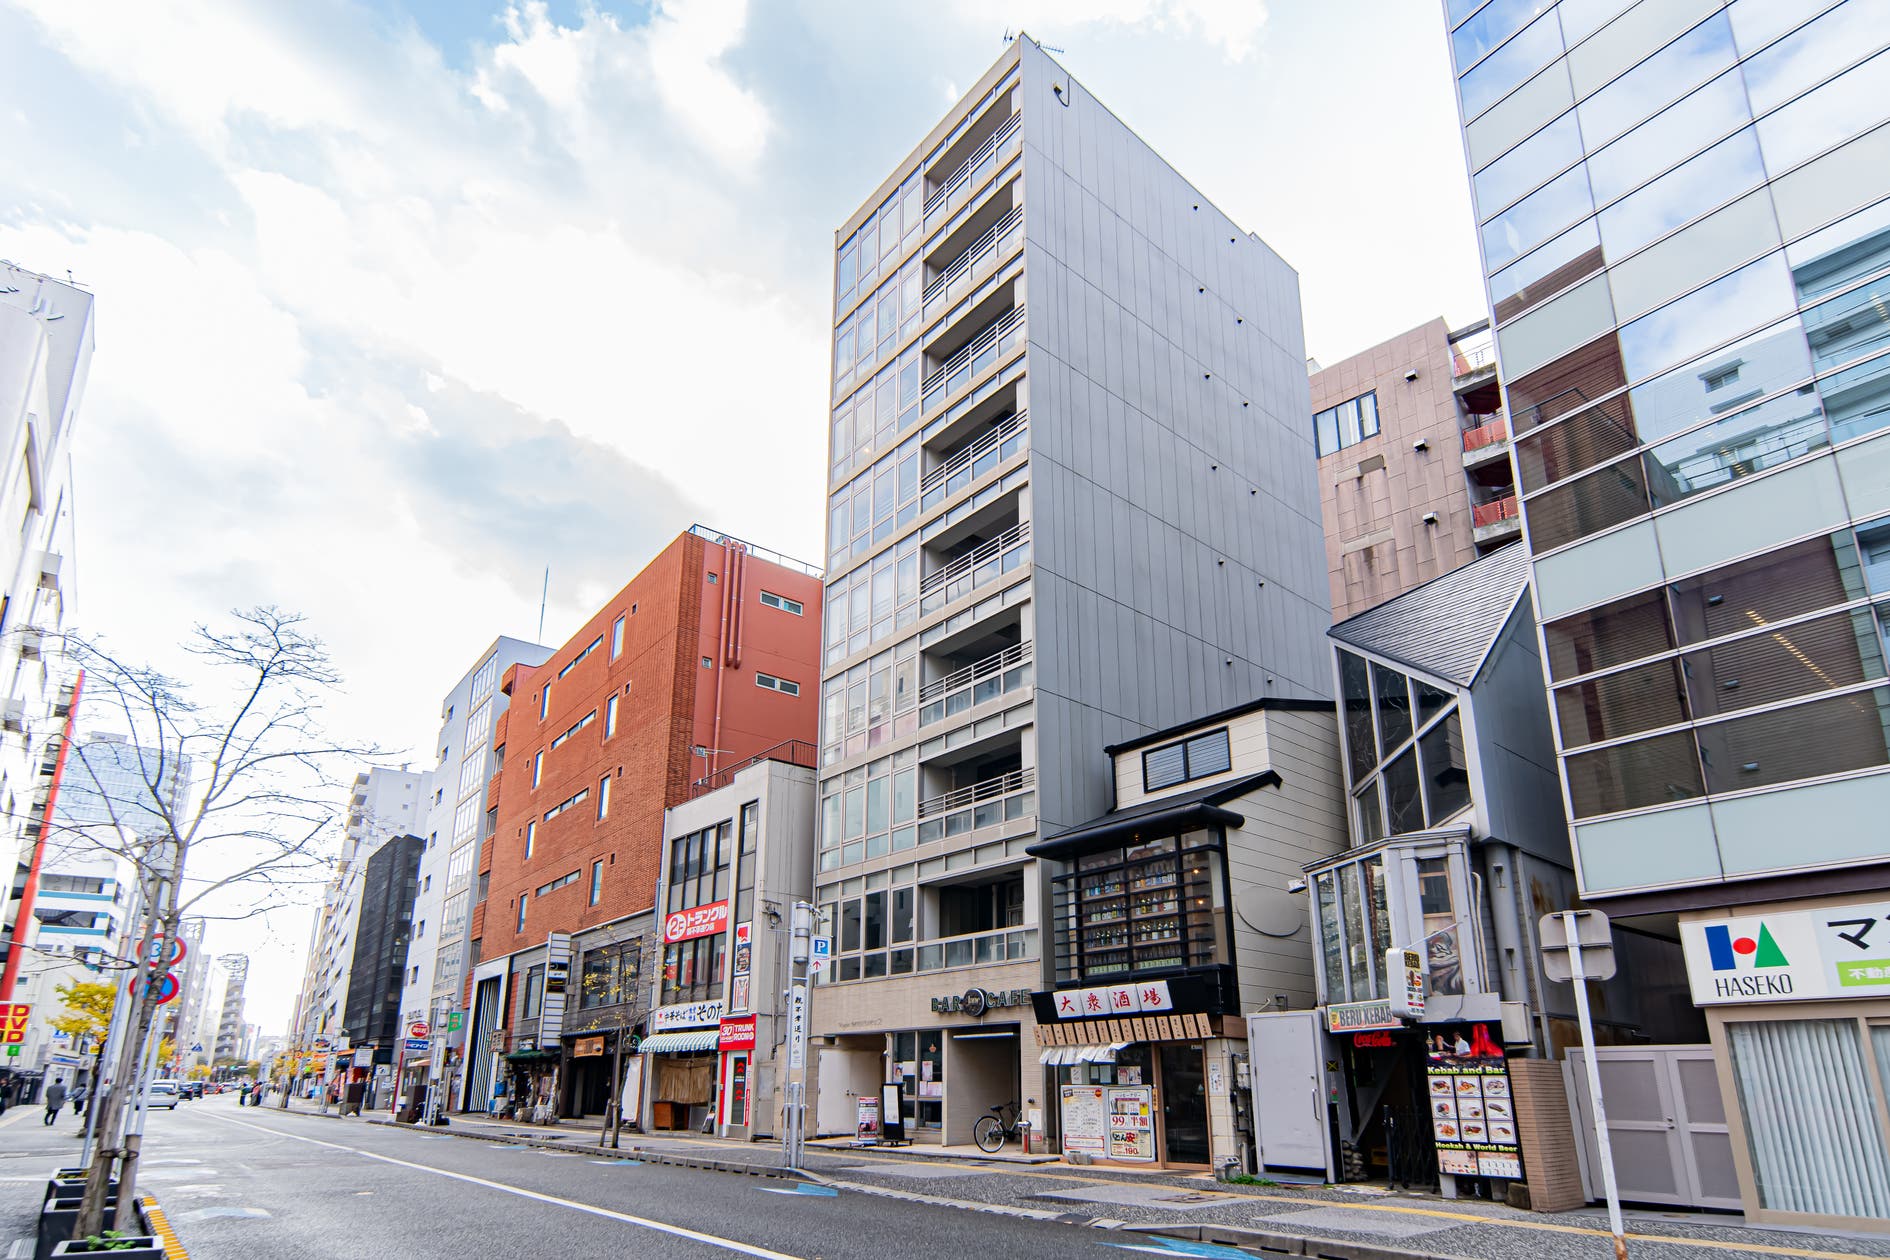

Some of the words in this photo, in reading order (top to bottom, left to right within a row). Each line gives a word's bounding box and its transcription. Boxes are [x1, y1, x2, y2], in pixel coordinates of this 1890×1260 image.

[817, 941, 826, 953] P
[1715, 974, 1793, 997] HASEKO
[931, 997, 961, 1013] BAR
[986, 989, 1031, 1009] CAFE
[1060, 988, 1162, 1014] 大衆酒場
[6, 1004, 30, 1043] DVD
[794, 996, 803, 1044] 親不孝通り
[1339, 1008, 1362, 1027] BERU
[1364, 1005, 1393, 1025] KEBAB
[734, 1024, 755, 1033] TRUNK
[1354, 1031, 1392, 1048] Coca-Cola
[1427, 1067, 1459, 1075] Kebab
[1462, 1067, 1482, 1075] and
[1485, 1066, 1505, 1075] Bar
[1435, 1142, 1464, 1150] Hookah
[1466, 1142, 1472, 1150] &
[1473, 1143, 1497, 1152] World
[1498, 1144, 1518, 1152] Beer
